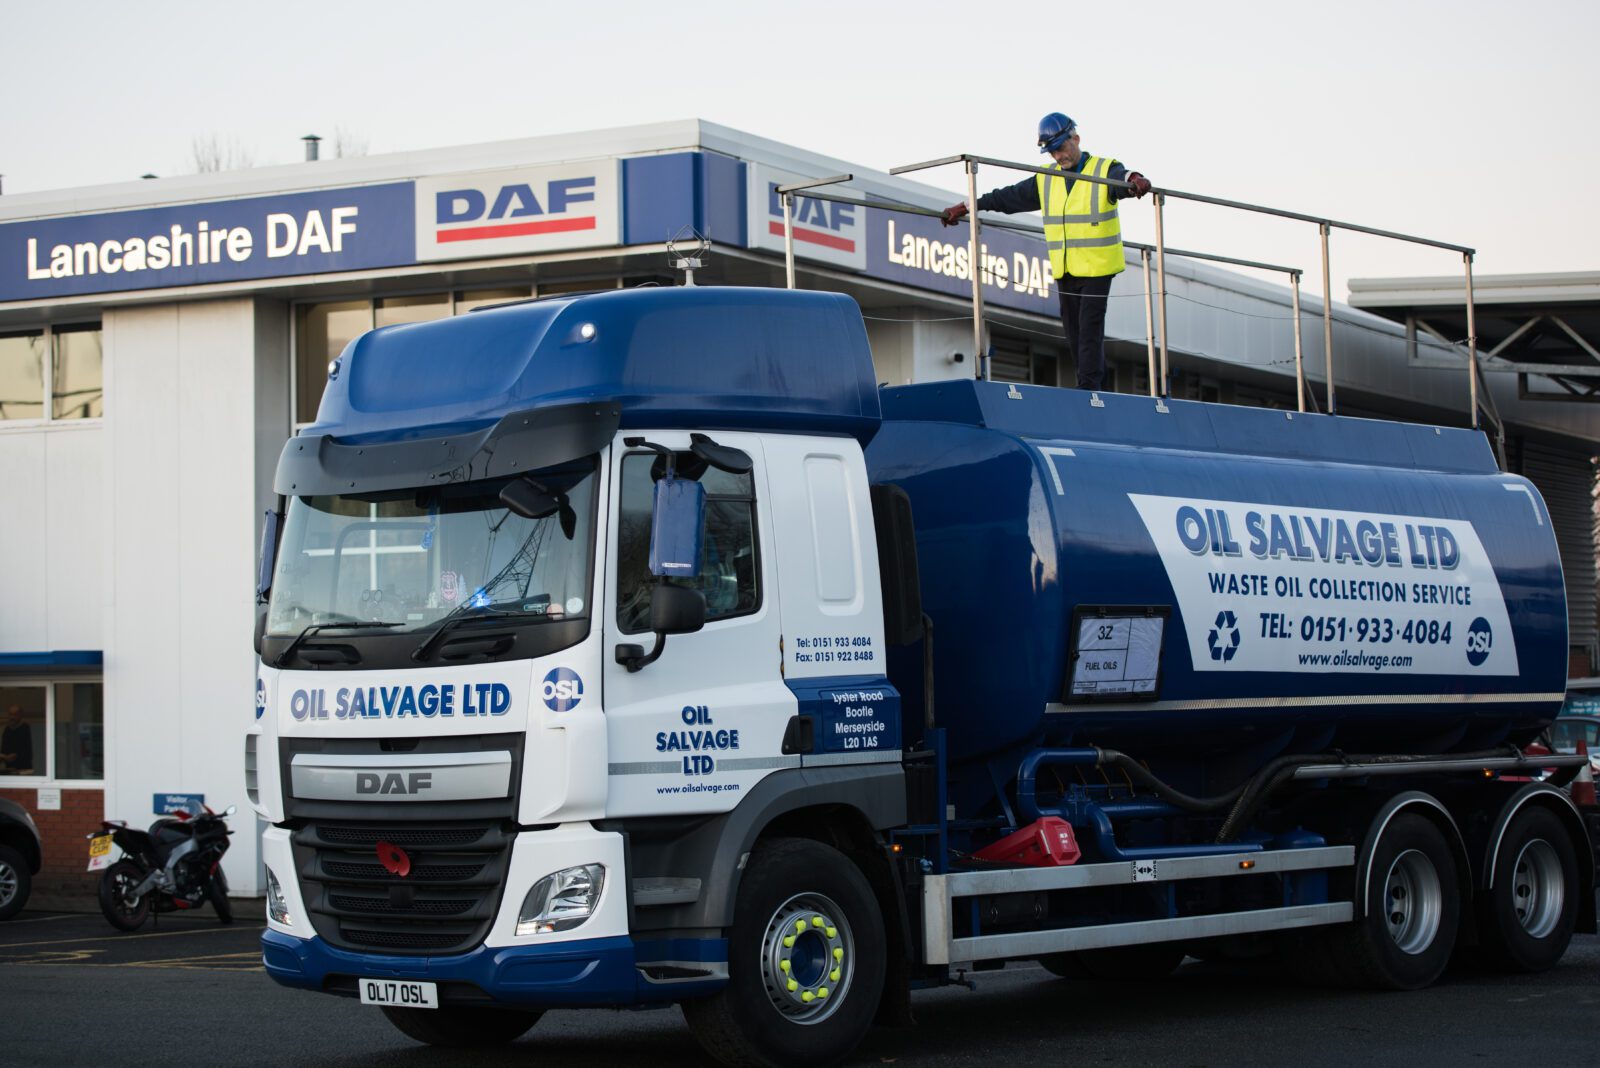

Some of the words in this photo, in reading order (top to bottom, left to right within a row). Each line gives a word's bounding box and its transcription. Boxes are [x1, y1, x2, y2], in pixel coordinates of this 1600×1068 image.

[436, 176, 596, 225] DAF
[27, 219, 252, 280] Lancashire
[266, 206, 358, 258] DAF
[888, 220, 1009, 289] Lancasire
[1175, 505, 1242, 557] OIL
[1245, 510, 1403, 568] SALVAGE
[1404, 523, 1461, 571] LTD
[1208, 572, 1268, 596] WASTE
[1275, 575, 1303, 597] OIL
[1309, 577, 1406, 602] COLLECTION
[1412, 583, 1471, 605] SERVICE
[1097, 625, 1114, 640] 3Z
[1260, 612, 1293, 639] TEL:
[796, 638, 811, 648] Tel:
[812, 637, 832, 648] 0151
[834, 637, 850, 647] 933
[851, 637, 872, 648] 4084
[1465, 630, 1491, 653] OSL
[795, 652, 813, 662] Fax:
[815, 652, 834, 662] 0151
[837, 651, 852, 662] 922
[854, 651, 874, 661] 8488
[1085, 662, 1101, 671] FUEL
[1102, 661, 1118, 670] OILS
[1298, 649, 1413, 670] www.oilsalvage.com
[542, 680, 584, 700] OSL
[831, 692, 858, 705] Lyster
[858, 691, 884, 701] Road
[290, 688, 330, 721] OIL
[335, 684, 455, 720] SALVAGE
[462, 682, 512, 716] LTD
[845, 705, 874, 718] Bootle
[681, 705, 713, 726] OIL
[835, 721, 885, 735] Merseyside
[656, 729, 740, 753] SALVAGE
[844, 737, 860, 749] L20
[862, 736, 878, 748] 1AS
[683, 755, 714, 776] LTD
[356, 772, 432, 795] DAF
[656, 783, 740, 794] www.oilsalvage.com
[367, 982, 396, 1003] OL17
[400, 984, 428, 1004] OSL
